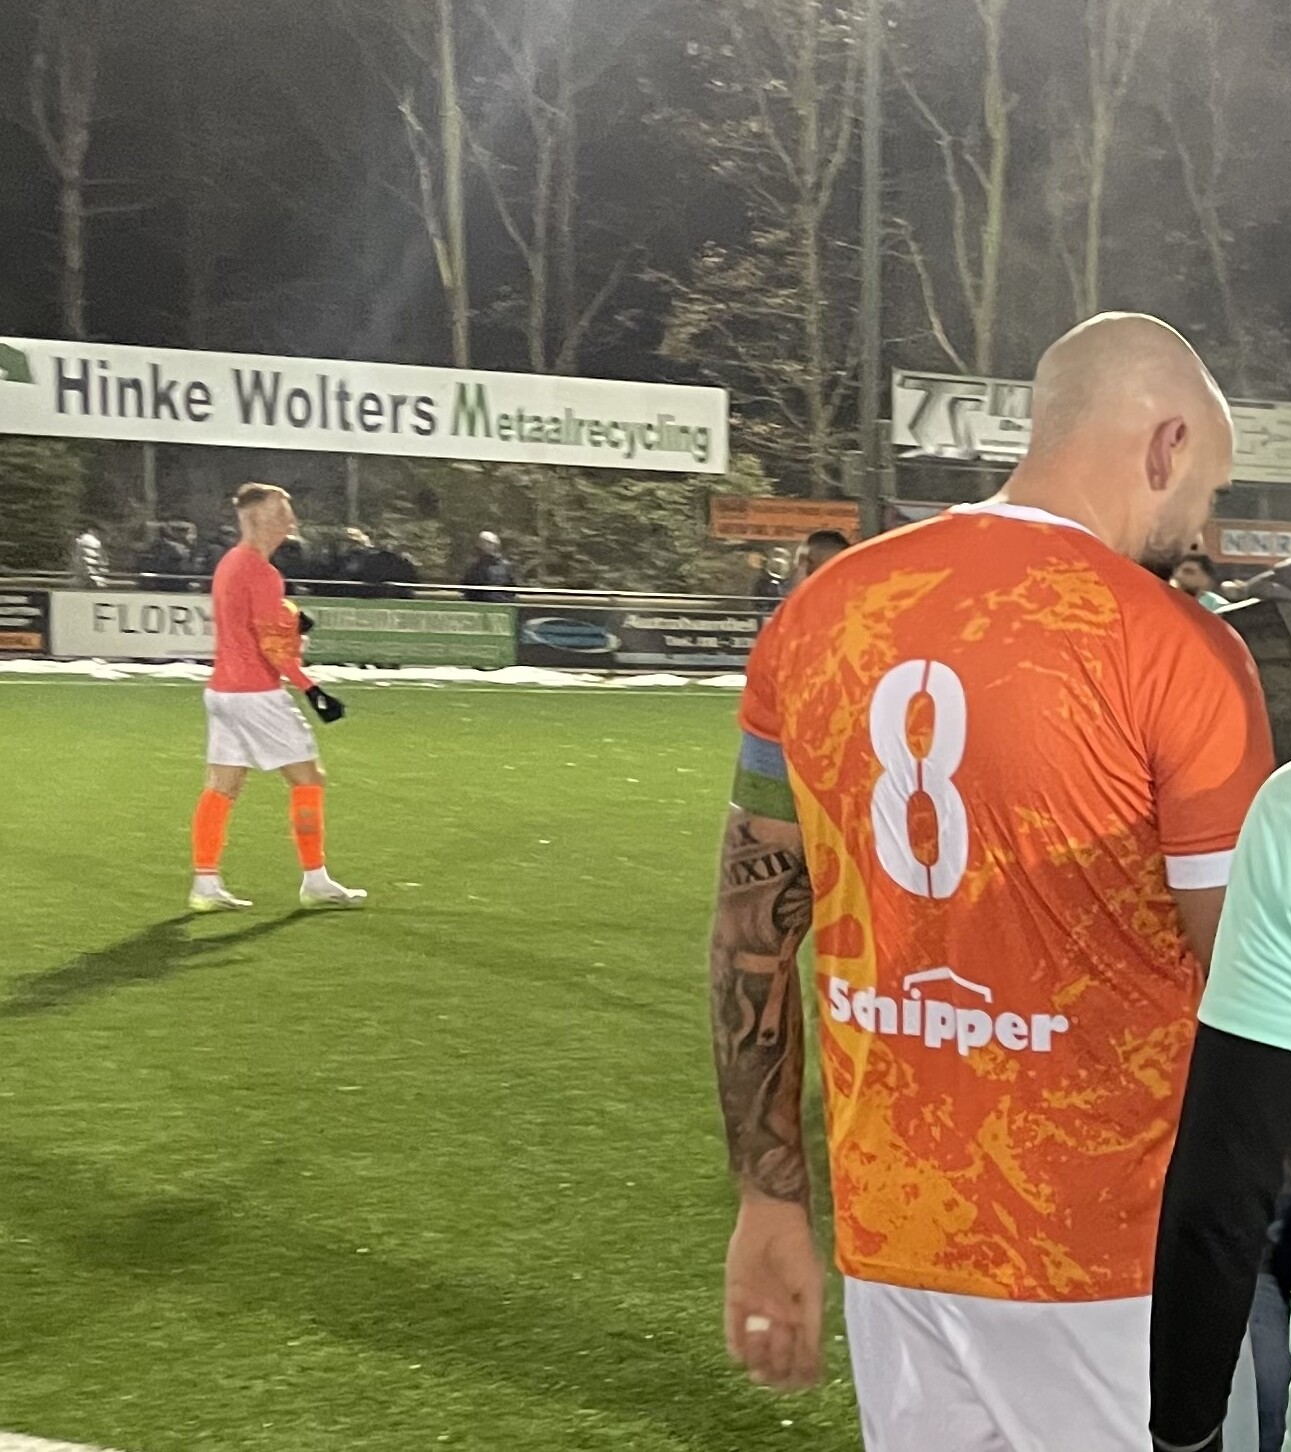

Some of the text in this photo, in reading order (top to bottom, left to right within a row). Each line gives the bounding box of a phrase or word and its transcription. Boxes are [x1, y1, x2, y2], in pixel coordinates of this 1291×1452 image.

[55, 356, 710, 463] Hinke Wolters Metaalrecycling
[869, 659, 969, 899] 8
[828, 977, 1069, 1056] Schipper
